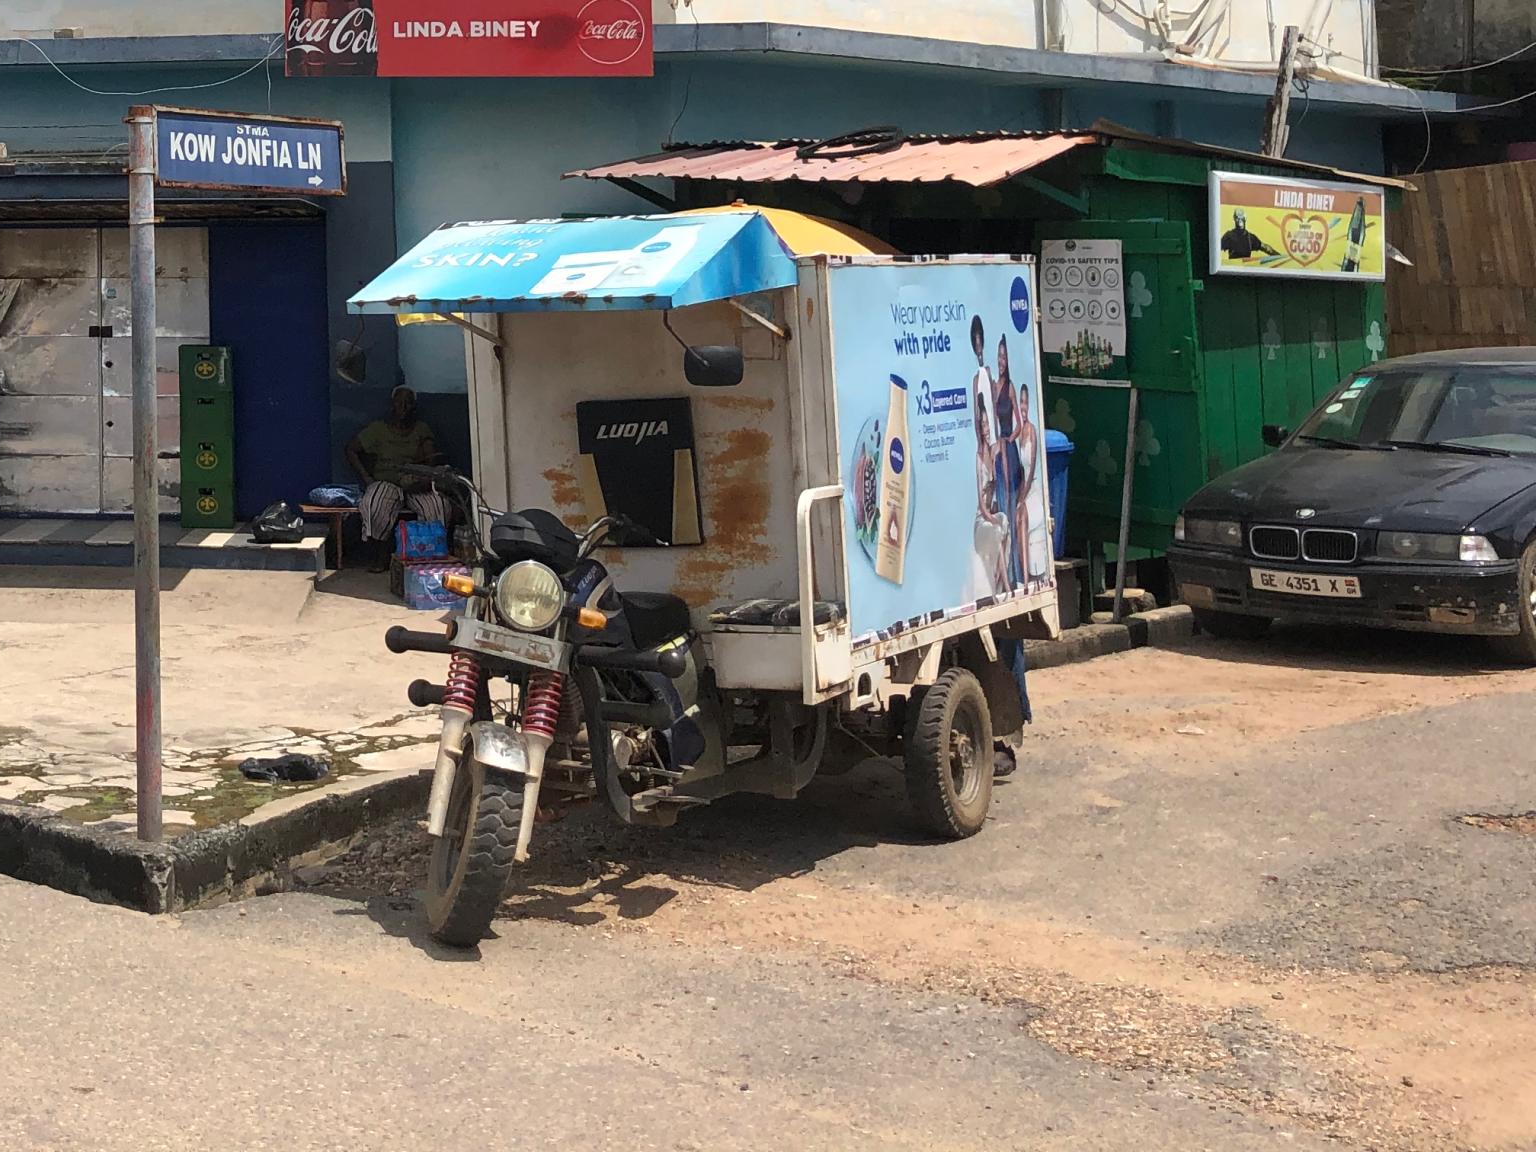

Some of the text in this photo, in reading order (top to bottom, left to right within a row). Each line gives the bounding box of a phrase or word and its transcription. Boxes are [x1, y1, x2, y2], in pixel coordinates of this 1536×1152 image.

[393, 20, 541, 38] LINDA BINEY
[580, 20, 640, 39] Coca-Cola
[236, 125, 269, 137] STMA
[170, 131, 322, 170] KOW JONFIA LN
[1274, 190, 1335, 211] LINDA BINEY
[1290, 239, 1320, 254] GOOD
[412, 251, 539, 268] SKIN?
[1045, 257, 1119, 265] COVID-19 SAFETY TIPS
[891, 301, 966, 328] Wear your skin
[1012, 299, 1028, 312] NIVEA
[895, 330, 951, 359] with pride
[596, 420, 668, 445] LUOJIA
[1261, 573, 1278, 587] GE
[1285, 576, 1320, 592] 4351
[1329, 579, 1339, 593] X
